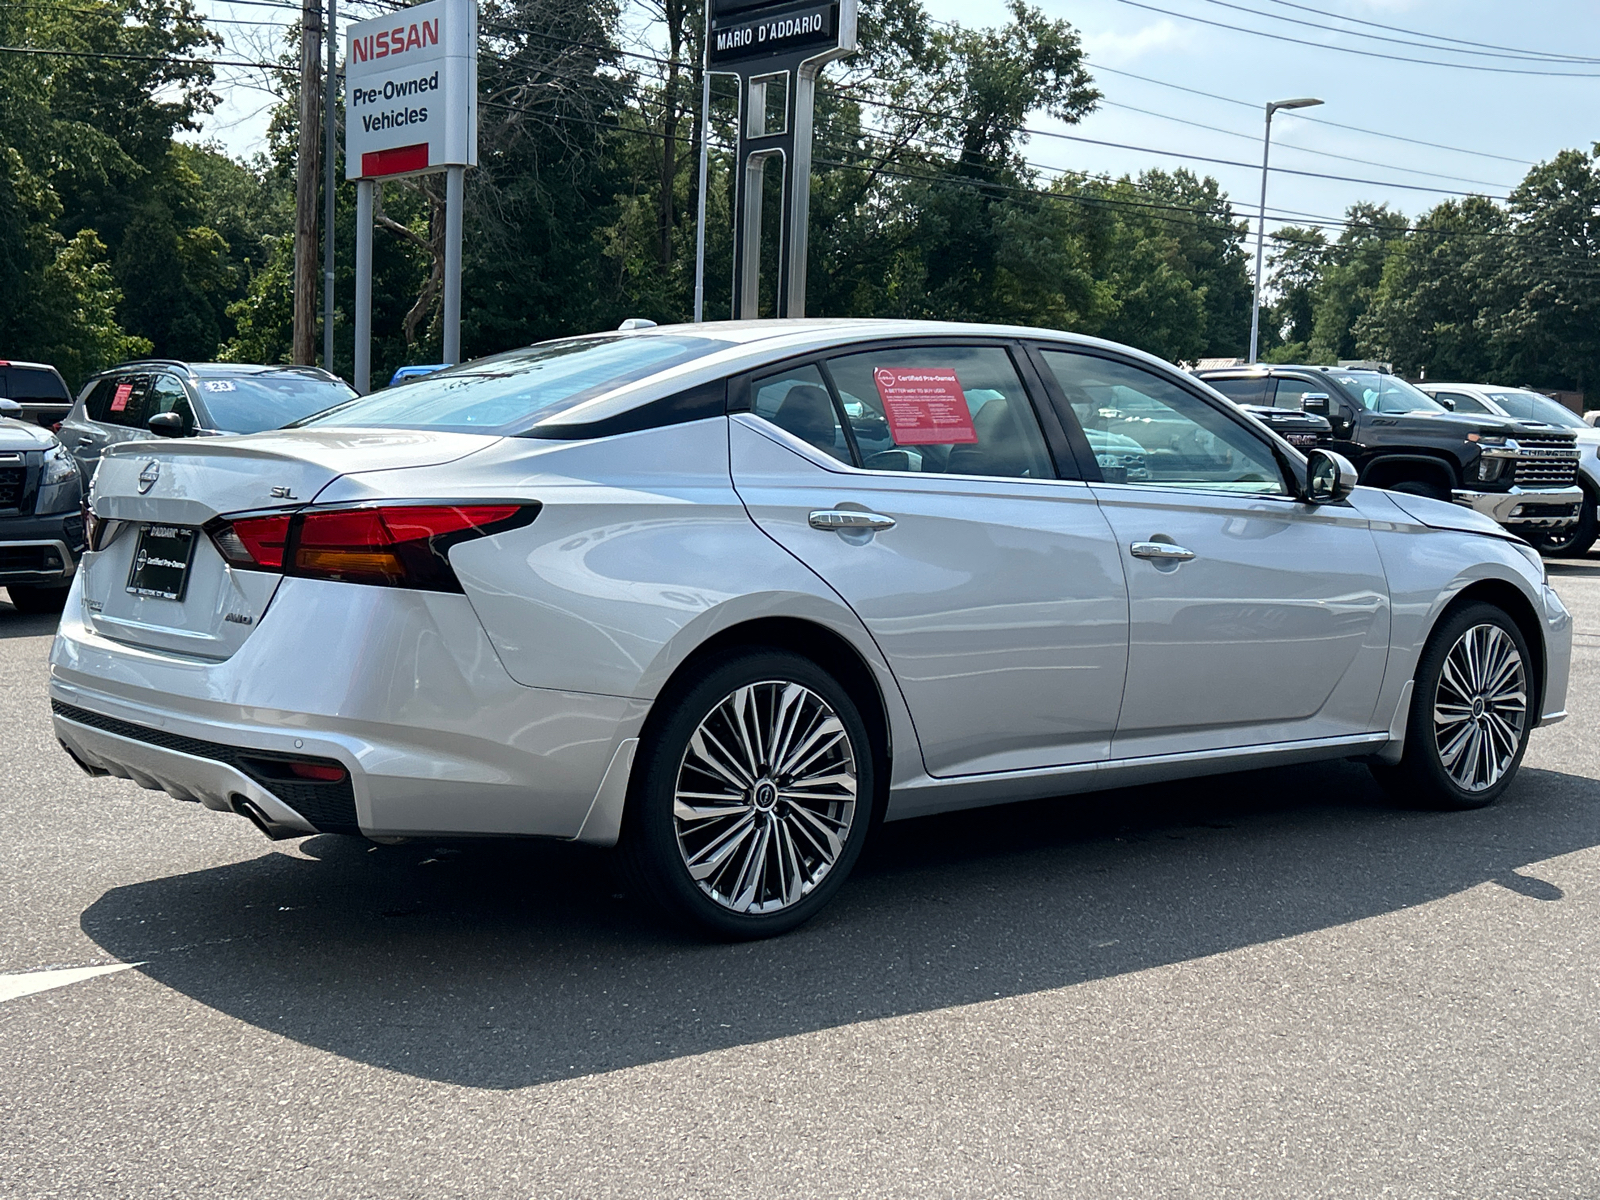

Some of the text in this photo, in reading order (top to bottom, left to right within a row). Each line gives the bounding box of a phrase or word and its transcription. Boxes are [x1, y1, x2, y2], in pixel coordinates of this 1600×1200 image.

[353, 18, 439, 65] NISSAN
[717, 13, 822, 51] MARIO D'ADDARIO
[353, 71, 439, 107] Pre-Owned
[362, 107, 428, 132] Vehicles
[211, 382, 229, 390] 23
[270, 486, 298, 500] SL
[225, 612, 253, 625] AWD
